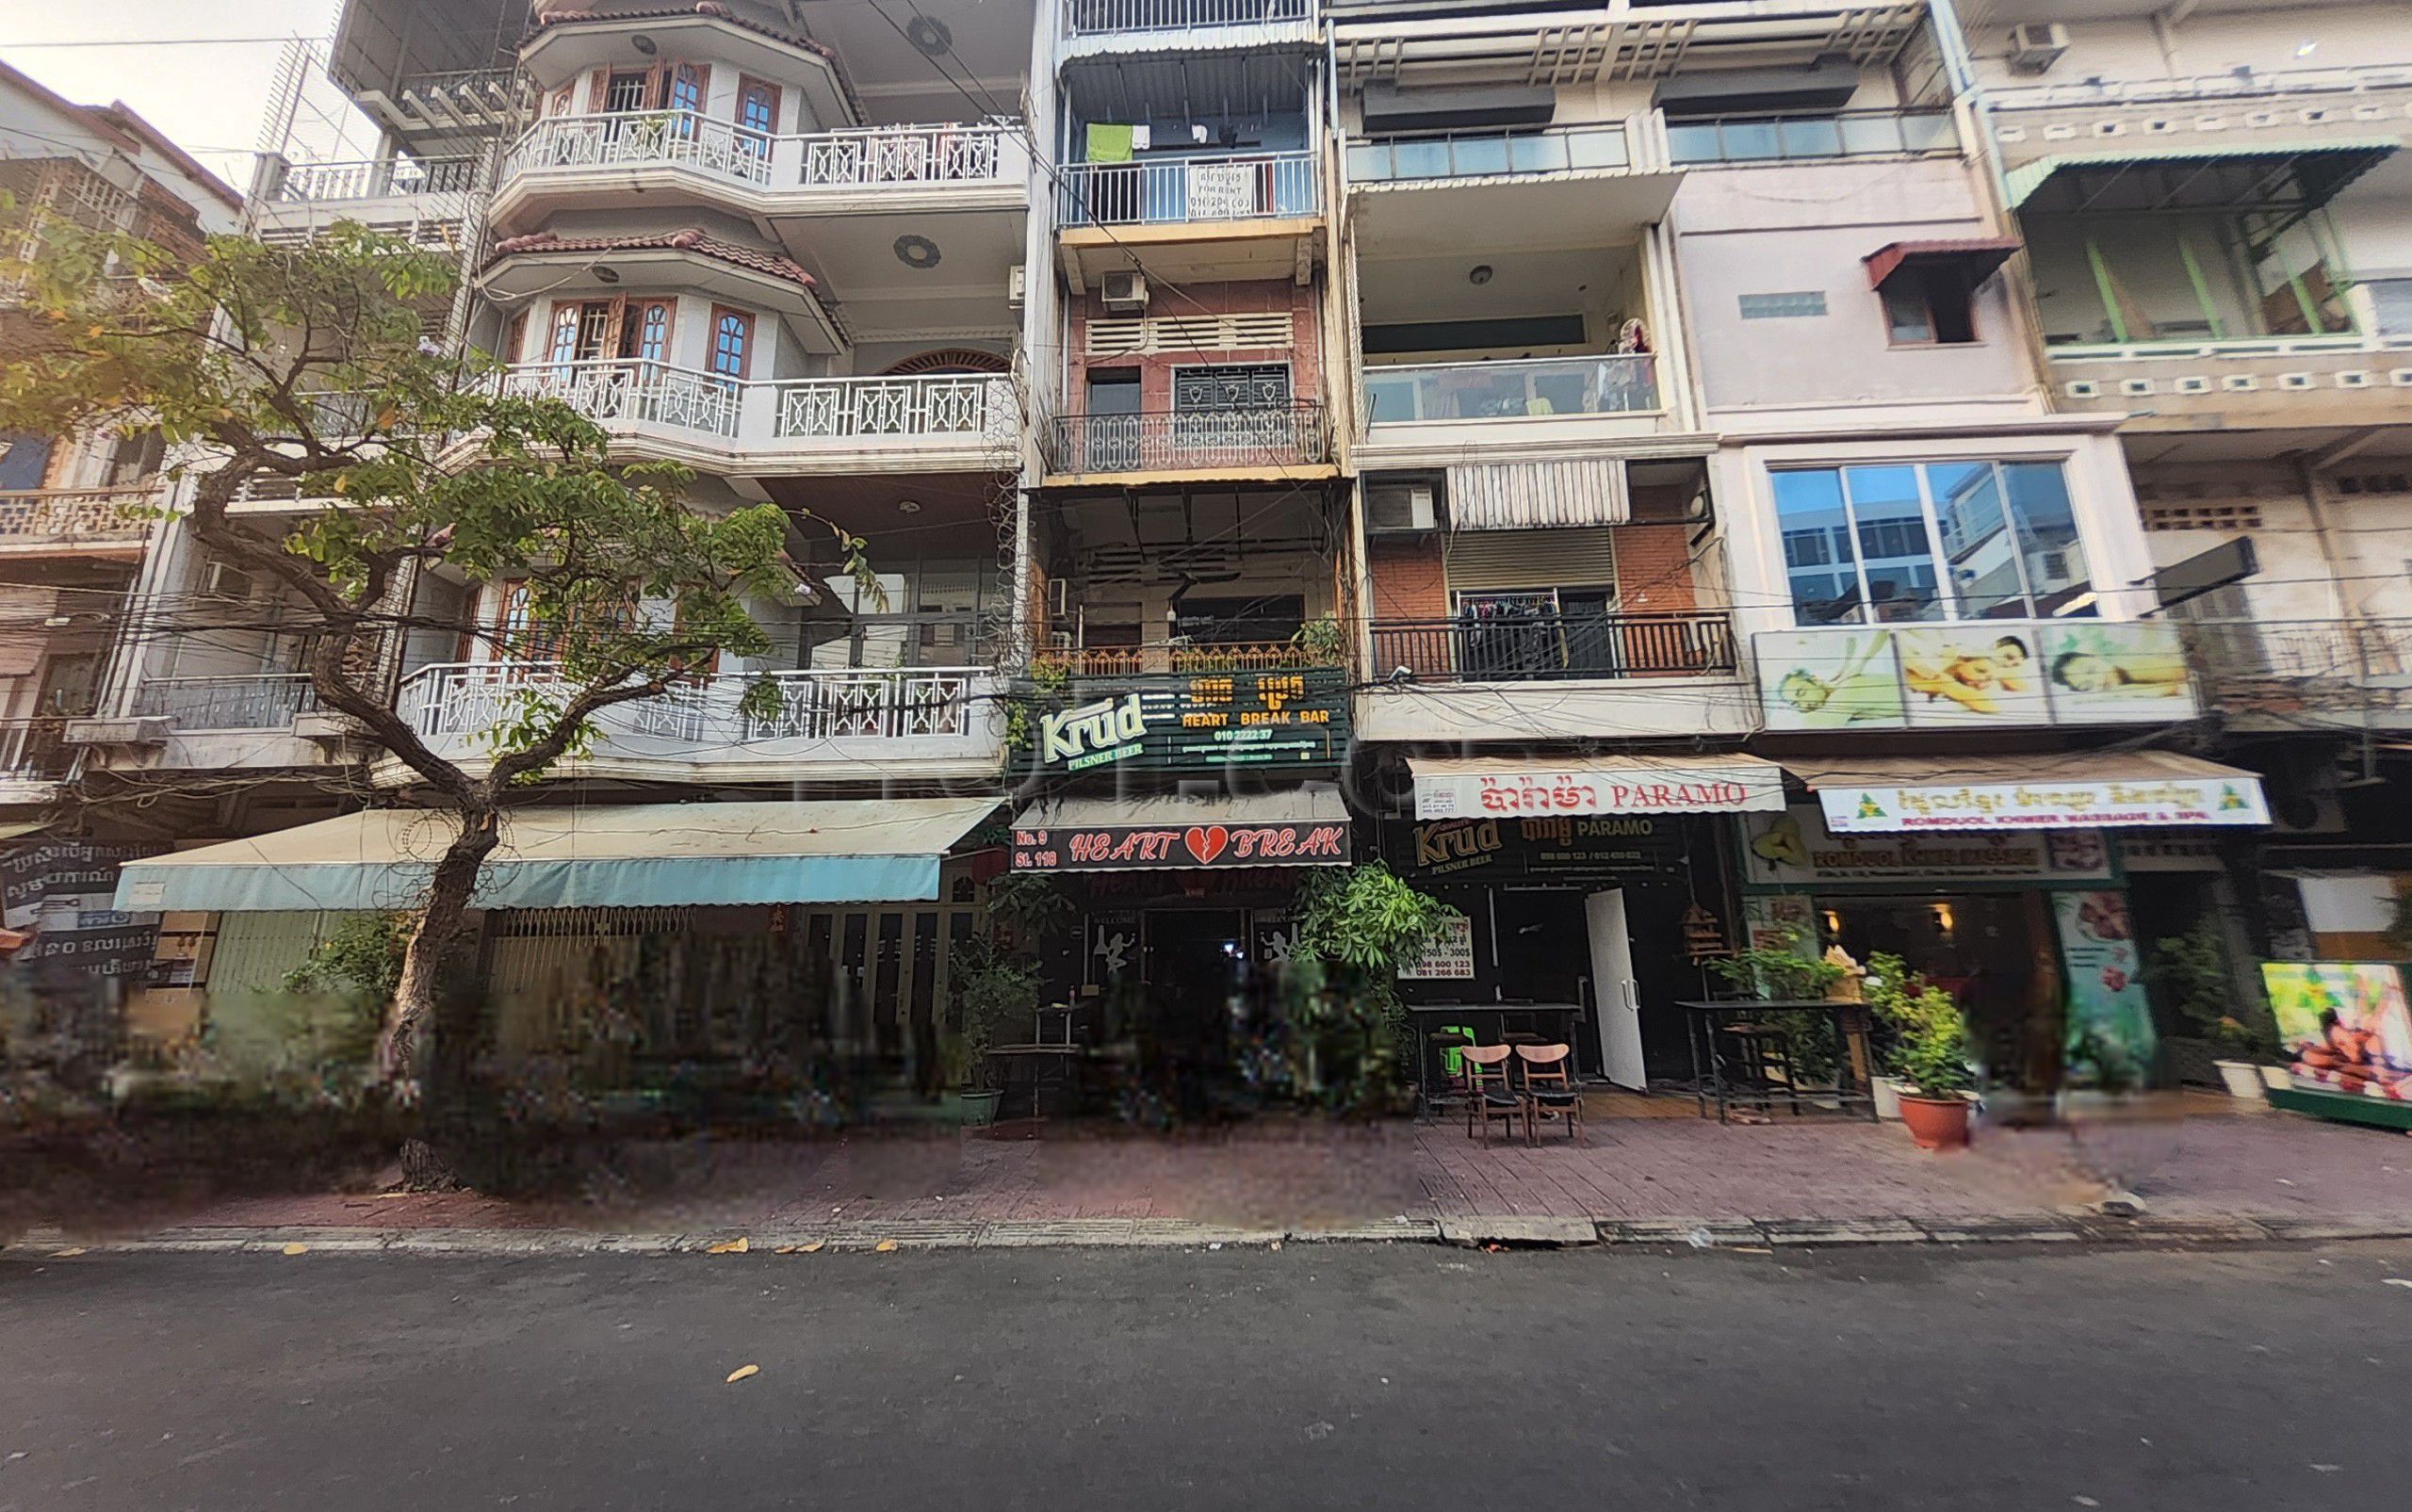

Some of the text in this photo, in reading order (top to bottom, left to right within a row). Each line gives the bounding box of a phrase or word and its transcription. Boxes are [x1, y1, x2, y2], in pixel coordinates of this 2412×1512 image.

[1039, 692, 1147, 763] Krud
[1182, 709, 1329, 728] HEART BREAK BAR
[1067, 743, 1144, 771] PILSNER BEER
[1610, 784, 1749, 808] PARAMO
[1017, 830, 1048, 846] No. 9
[1577, 818, 1654, 837] PARAMO
[1069, 826, 1343, 862] HEART BREAK
[1413, 819, 1503, 868] Krud
[1015, 851, 1057, 868] St. 118
[1431, 854, 1493, 874] PILSNER BEER
